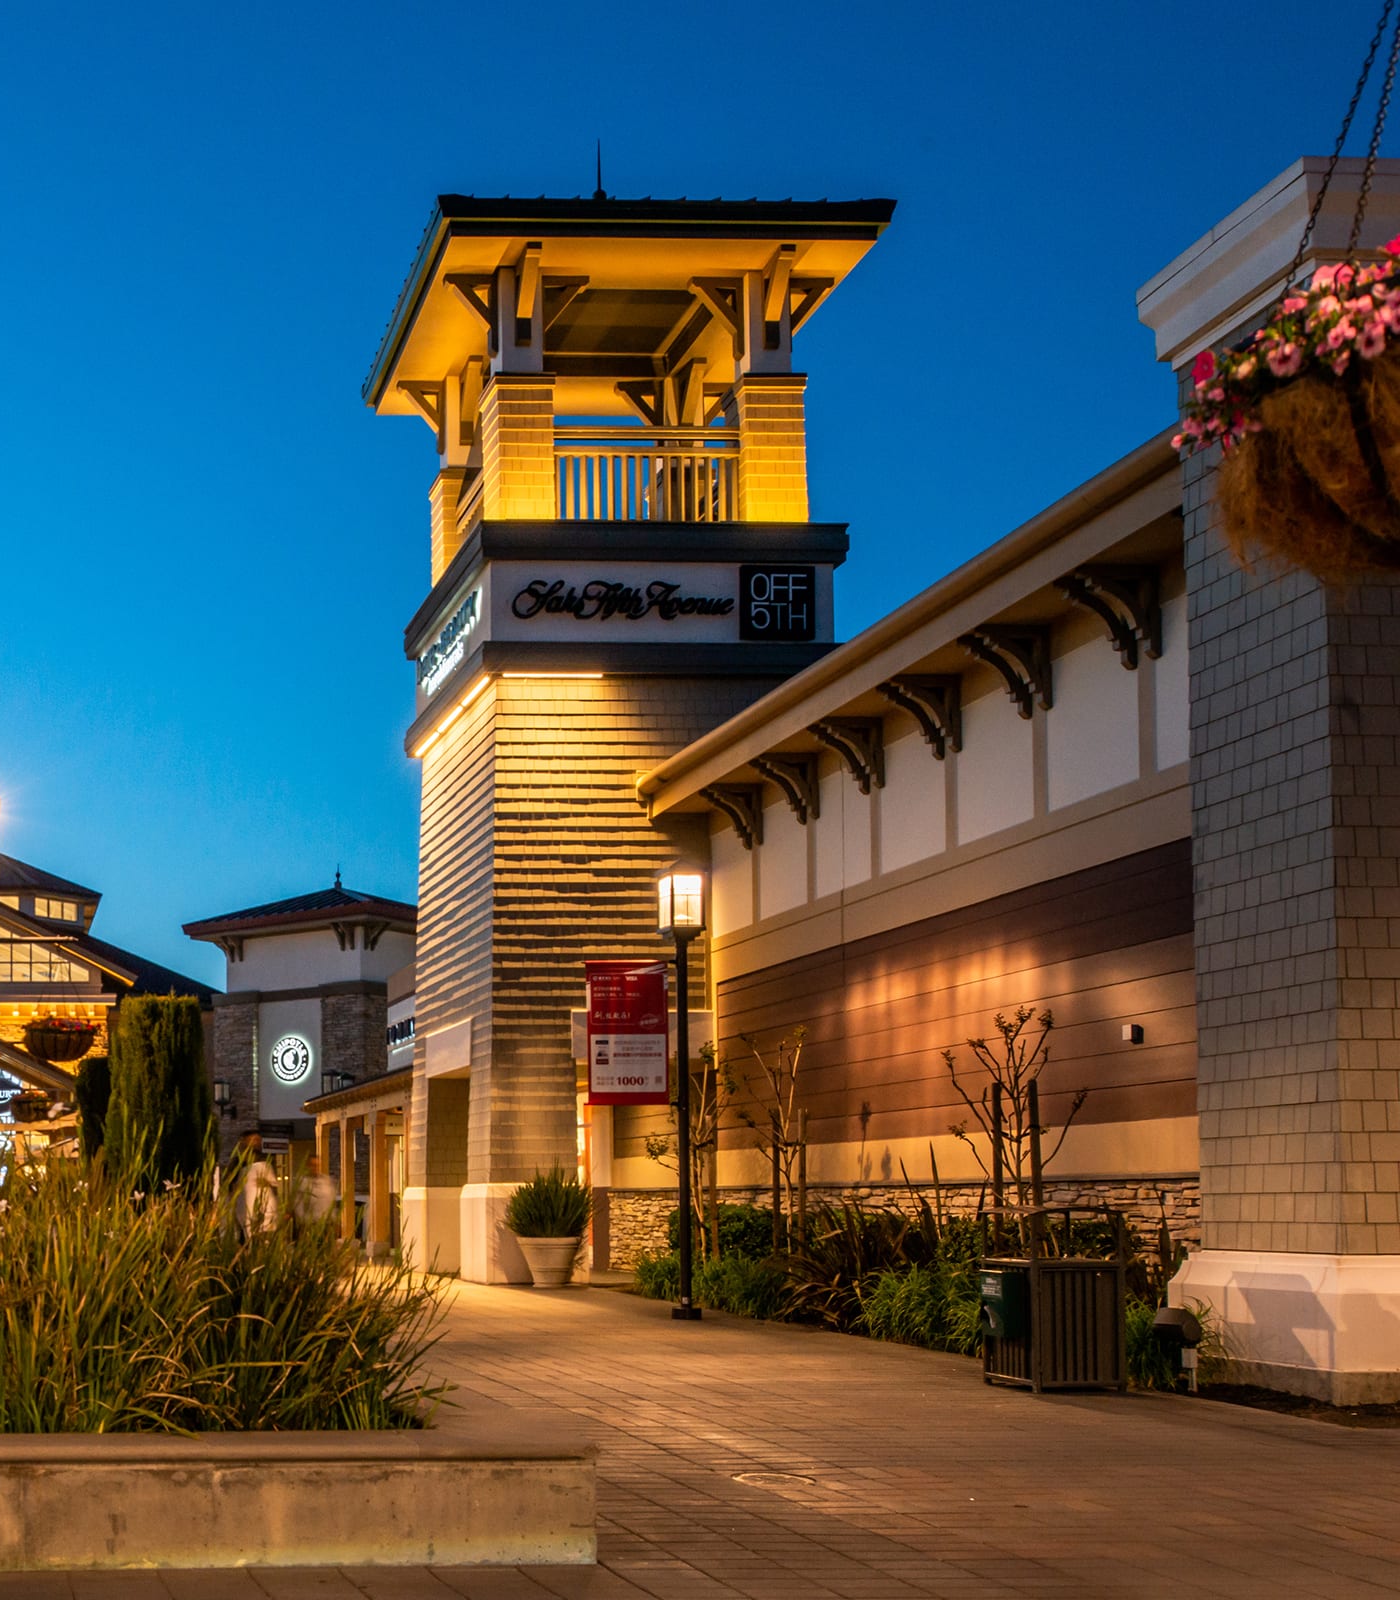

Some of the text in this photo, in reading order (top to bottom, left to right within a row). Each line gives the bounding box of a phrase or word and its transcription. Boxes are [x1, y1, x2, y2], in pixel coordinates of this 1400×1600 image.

[512, 580, 734, 621] Saks Fifth Avenue
[750, 573, 807, 601] OFF
[751, 602, 807, 629] 5TH
[273, 1038, 307, 1057] CHIPOTLE
[617, 1076, 644, 1086] 1000
